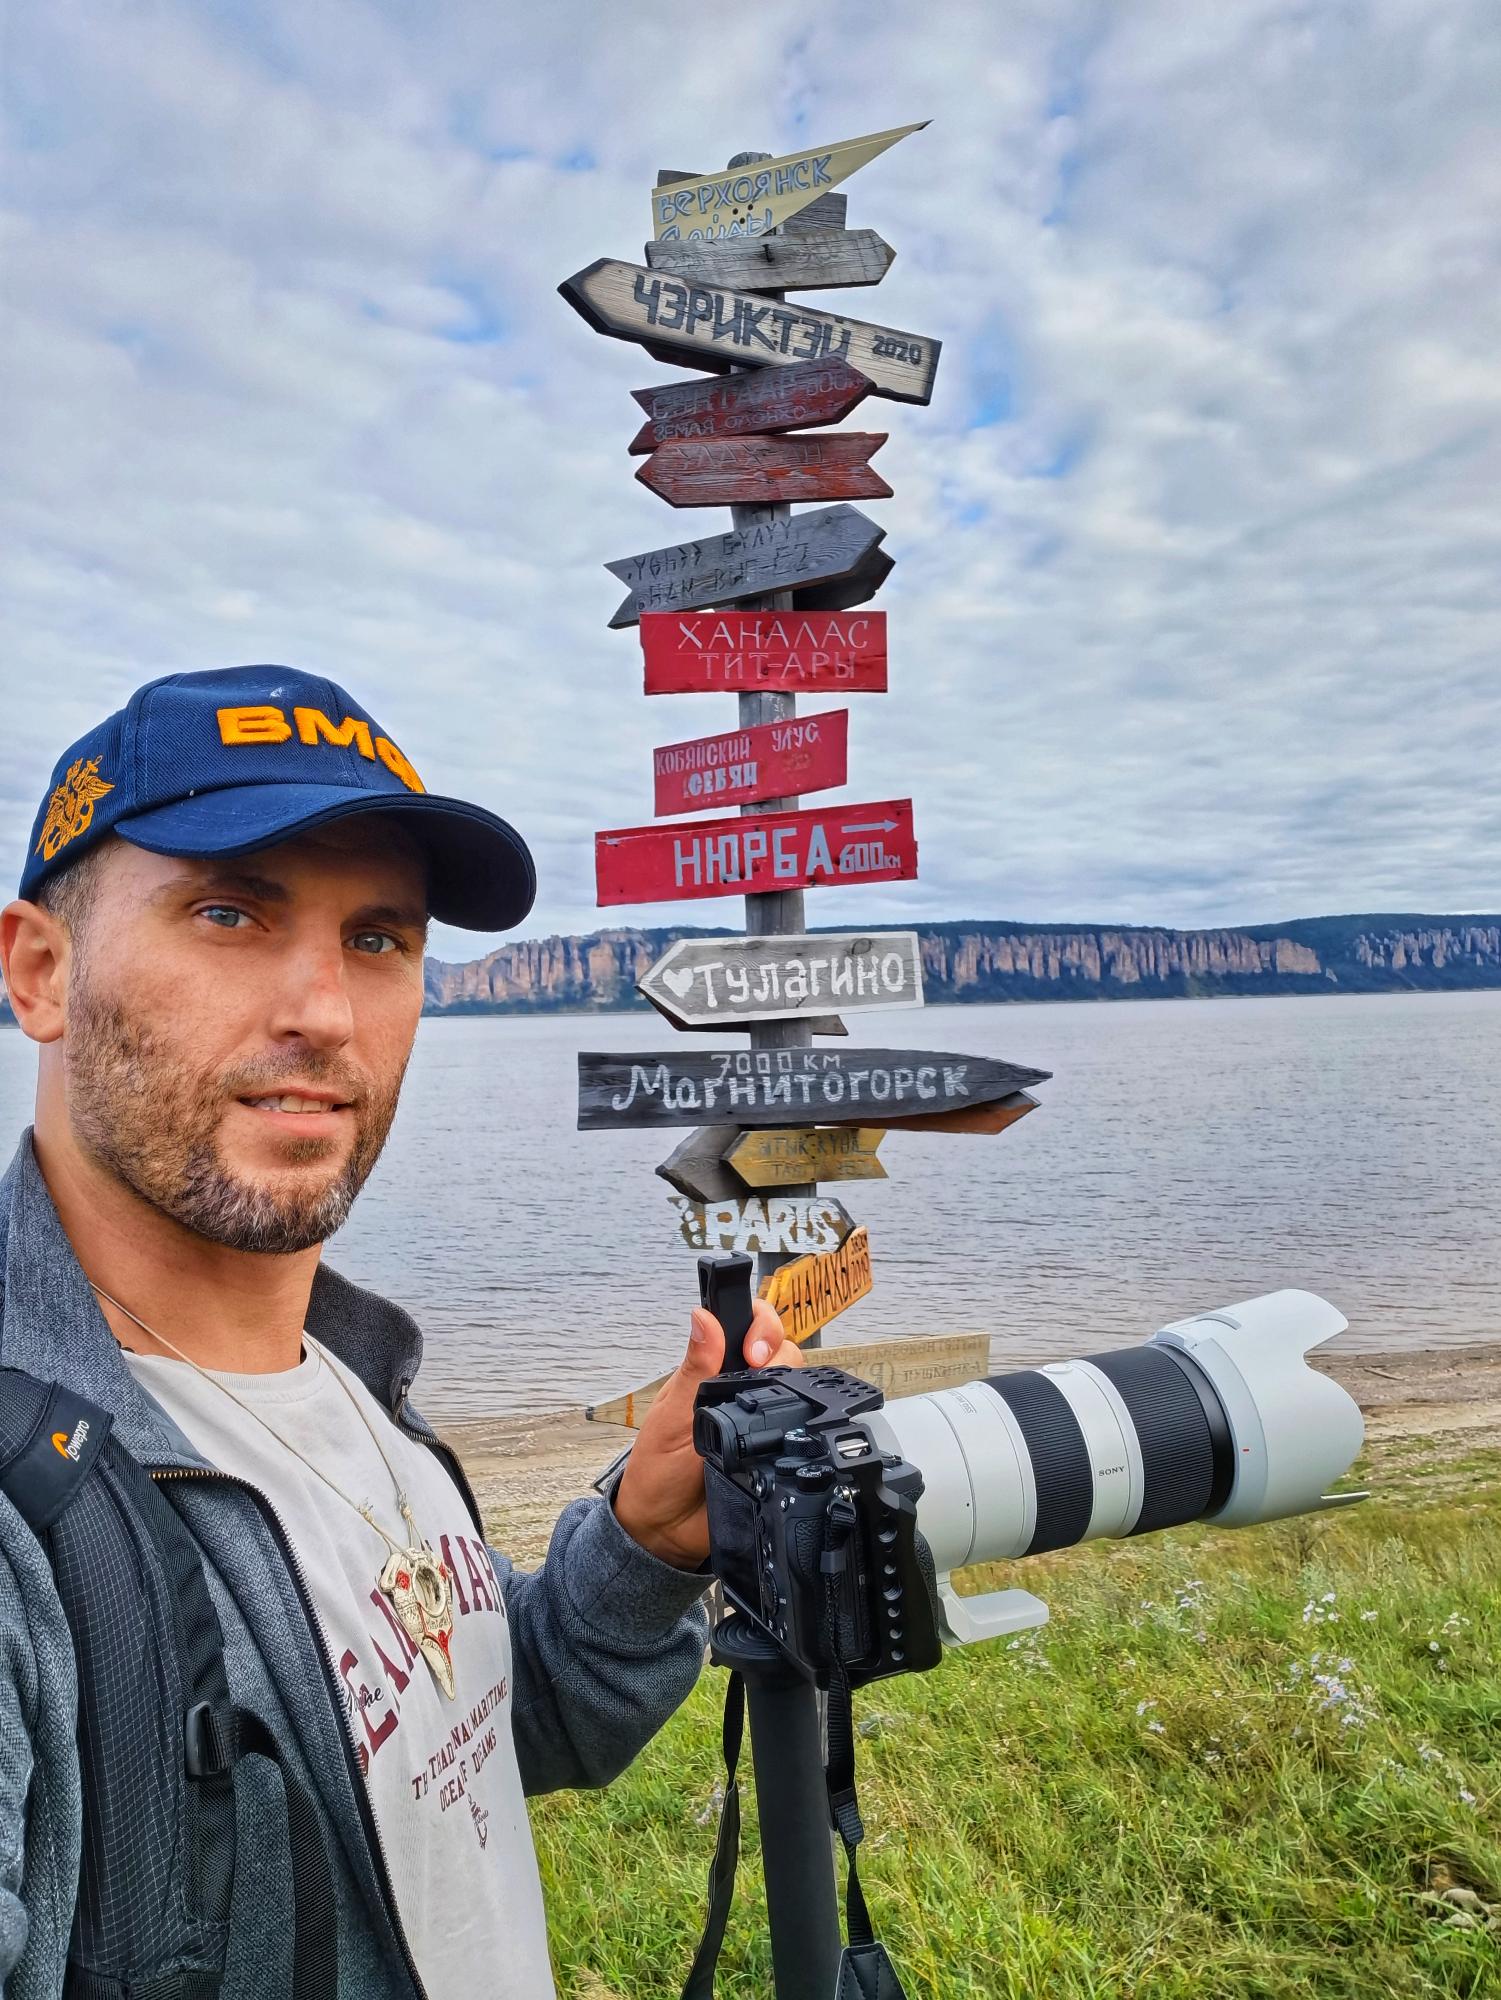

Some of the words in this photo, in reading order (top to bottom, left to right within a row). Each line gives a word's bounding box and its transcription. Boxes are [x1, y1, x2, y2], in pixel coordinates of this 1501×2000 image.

[872, 334, 922, 365] 2020
[698, 651, 856, 680] ТИТ-АРЫ
[656, 733, 751, 777] КОБЯЙСКИЙ
[771, 721, 820, 753] УЛУС
[687, 761, 758, 796] СЕБЯН
[673, 824, 834, 887] НЮРБА
[711, 1052, 793, 1079] 7000
[704, 1198, 842, 1253] PARIS
[65, 1420, 90, 1462] Lowepro
[1098, 1466, 1125, 1477] SONY
